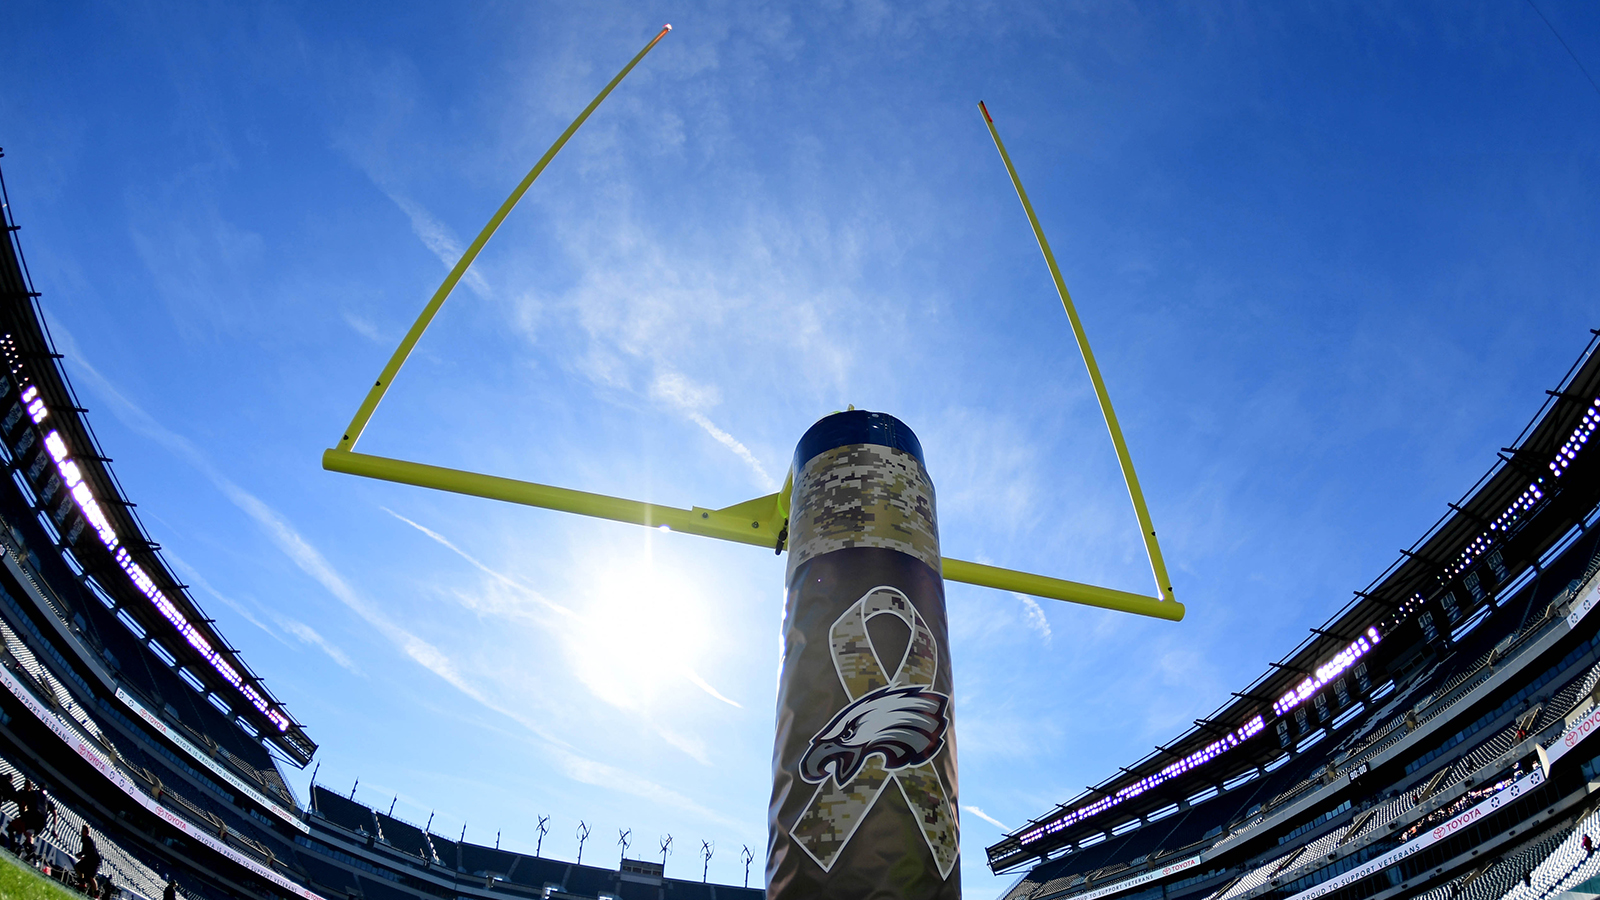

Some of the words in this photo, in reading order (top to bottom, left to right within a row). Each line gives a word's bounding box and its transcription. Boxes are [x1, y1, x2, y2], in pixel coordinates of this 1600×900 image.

[4, 677, 12, 688] TO
[14, 688, 40, 715] SUPPORT
[41, 714, 70, 743] VETERANS
[147, 715, 167, 733] TOYOTA
[86, 750, 106, 771] TOYOTA
[173, 735, 191, 753] TOYOTA
[198, 755, 215, 769] PROUD
[216, 767, 223, 775] TO
[223, 773, 242, 789] SUPPORT
[243, 787, 265, 804] VETERANS
[164, 812, 187, 830] TOYOTA
[1446, 808, 1481, 832] TOYOTA
[193, 832, 214, 847] TOYOTA
[223, 850, 240, 864] PROUD
[243, 860, 250, 868] TO
[251, 865, 273, 879] SUPPORT
[274, 877, 297, 892] VETERANS
[1172, 859, 1196, 872] TOYOTA
[1302, 887, 1326, 900] PROUD
[1329, 882, 1339, 891] TO
[1341, 865, 1375, 886] SUPPORT
[1378, 843, 1421, 868] VETERANS
[1098, 884, 1123, 896] SUPPORT
[1125, 875, 1154, 888] VETERANS
